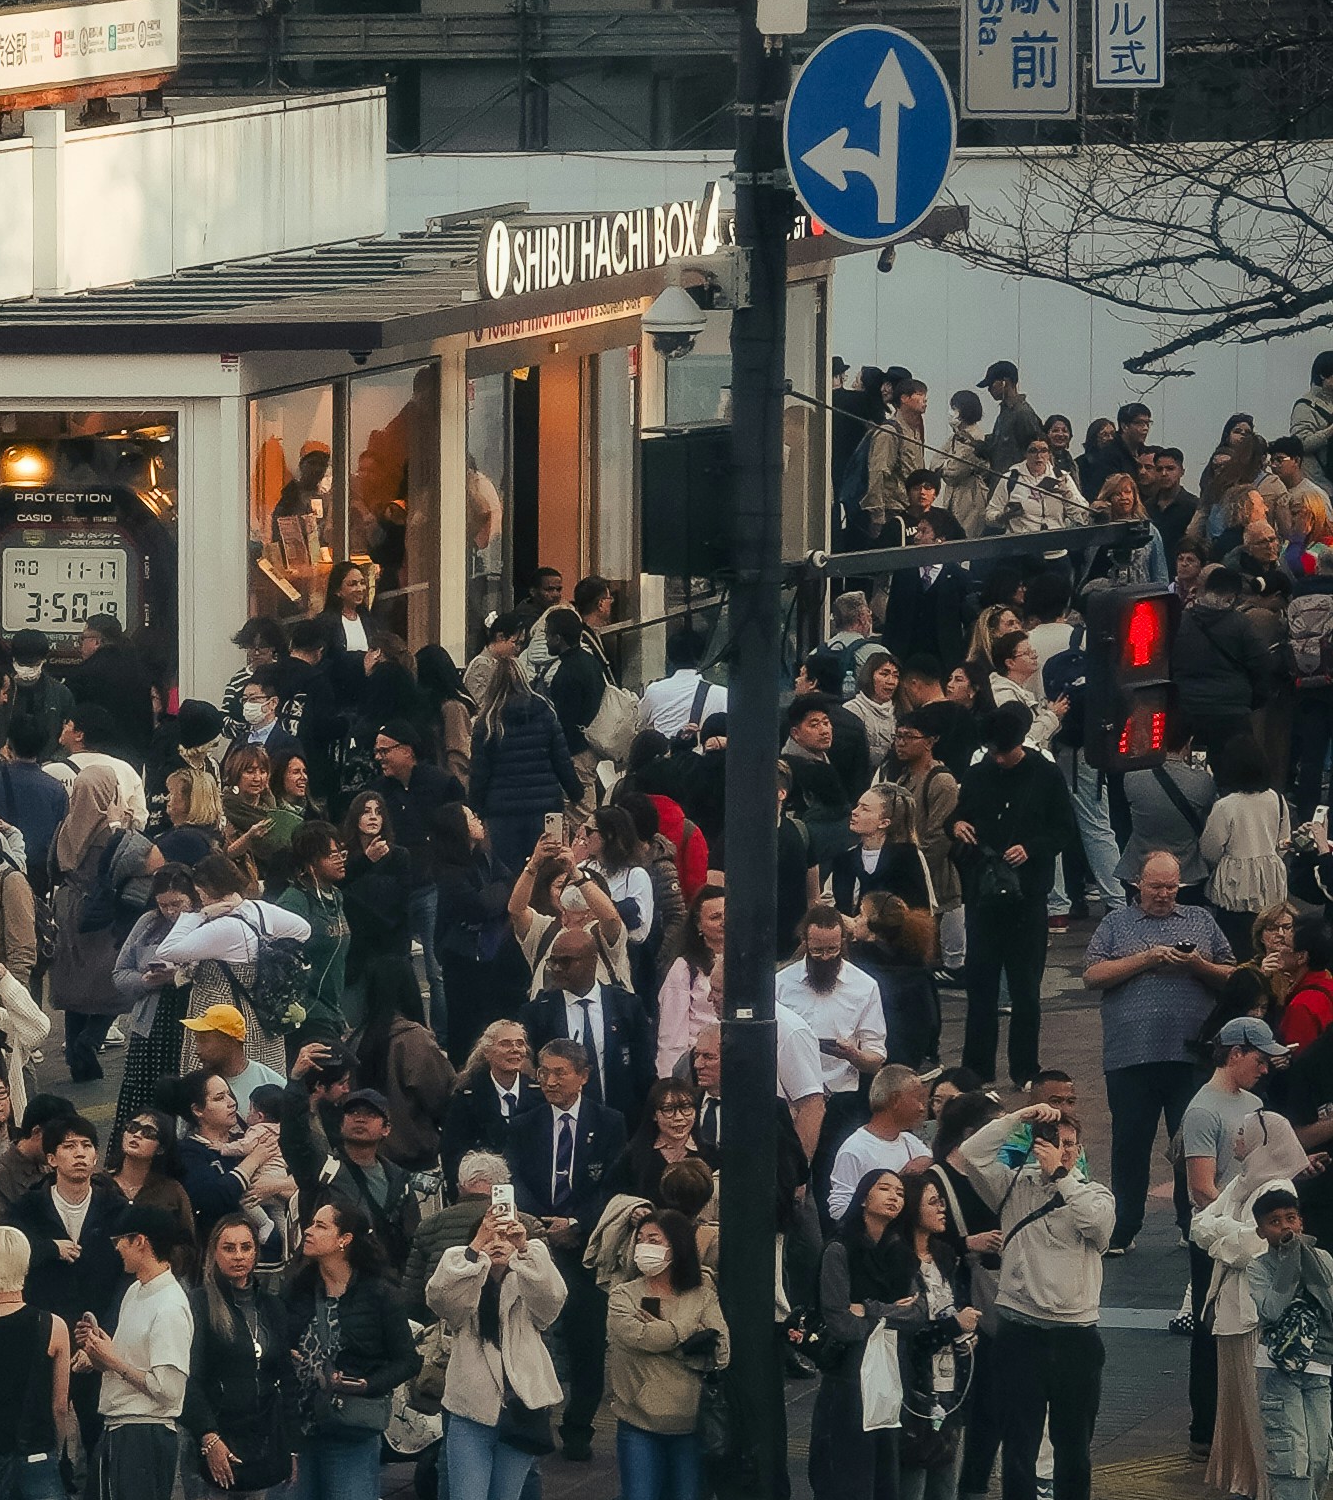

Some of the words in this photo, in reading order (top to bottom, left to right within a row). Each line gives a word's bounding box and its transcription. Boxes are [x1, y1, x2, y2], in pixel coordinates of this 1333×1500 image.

[512, 222, 576, 297] SHIBU
[581, 210, 649, 282] HACHI
[653, 199, 699, 267] BOX
[14, 492, 112, 503] PROTECTION
[17, 513, 52, 523] CASIO
[26, 592, 88, 623] 3:50
